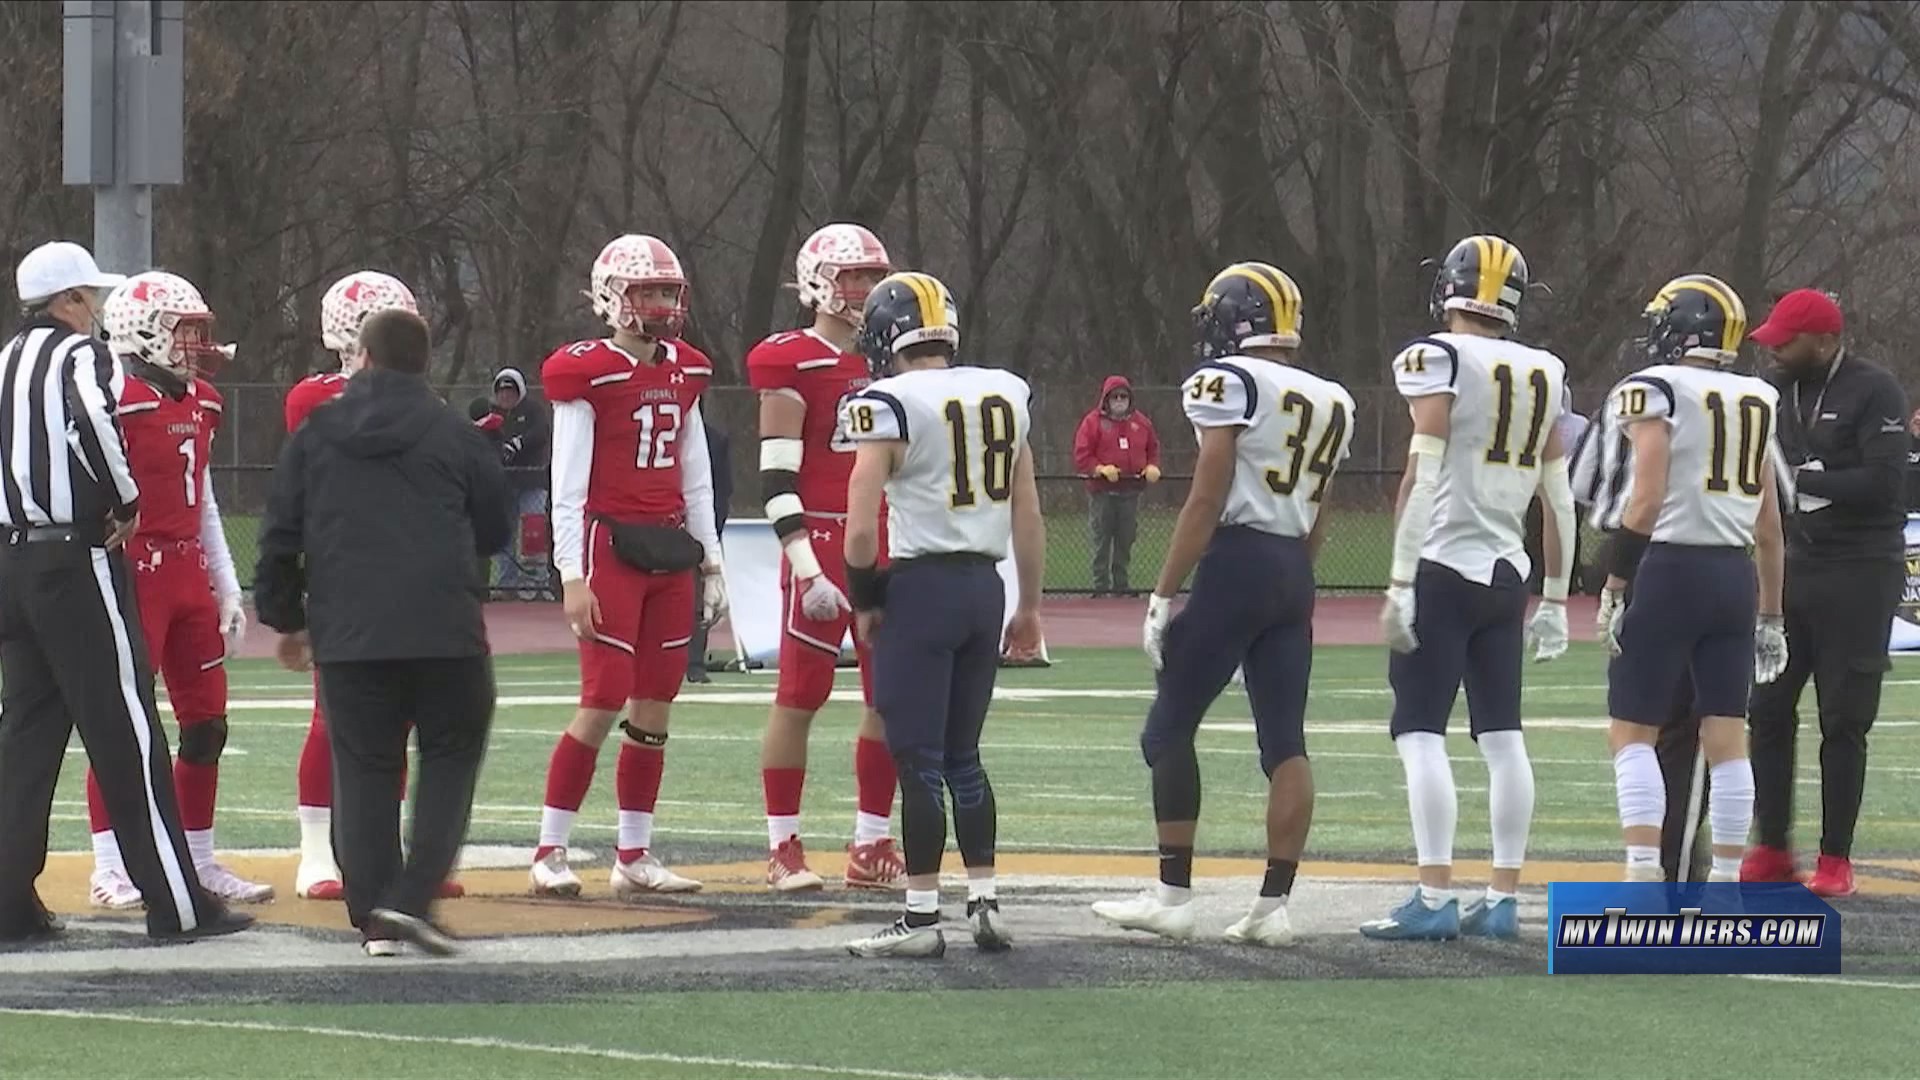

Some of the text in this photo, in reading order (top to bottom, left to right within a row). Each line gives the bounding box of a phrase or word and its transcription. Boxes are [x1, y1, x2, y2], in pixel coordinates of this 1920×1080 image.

[1190, 373, 1226, 404] 34
[1404, 348, 1426, 372] 11
[848, 404, 874, 433] 18
[1486, 363, 1549, 468] 11
[1618, 387, 1647, 416] 10
[632, 403, 682, 469] 12
[944, 394, 1016, 509] 18
[1265, 389, 1347, 503] 34
[1704, 391, 1771, 496] 10
[178, 437, 197, 507] 1
